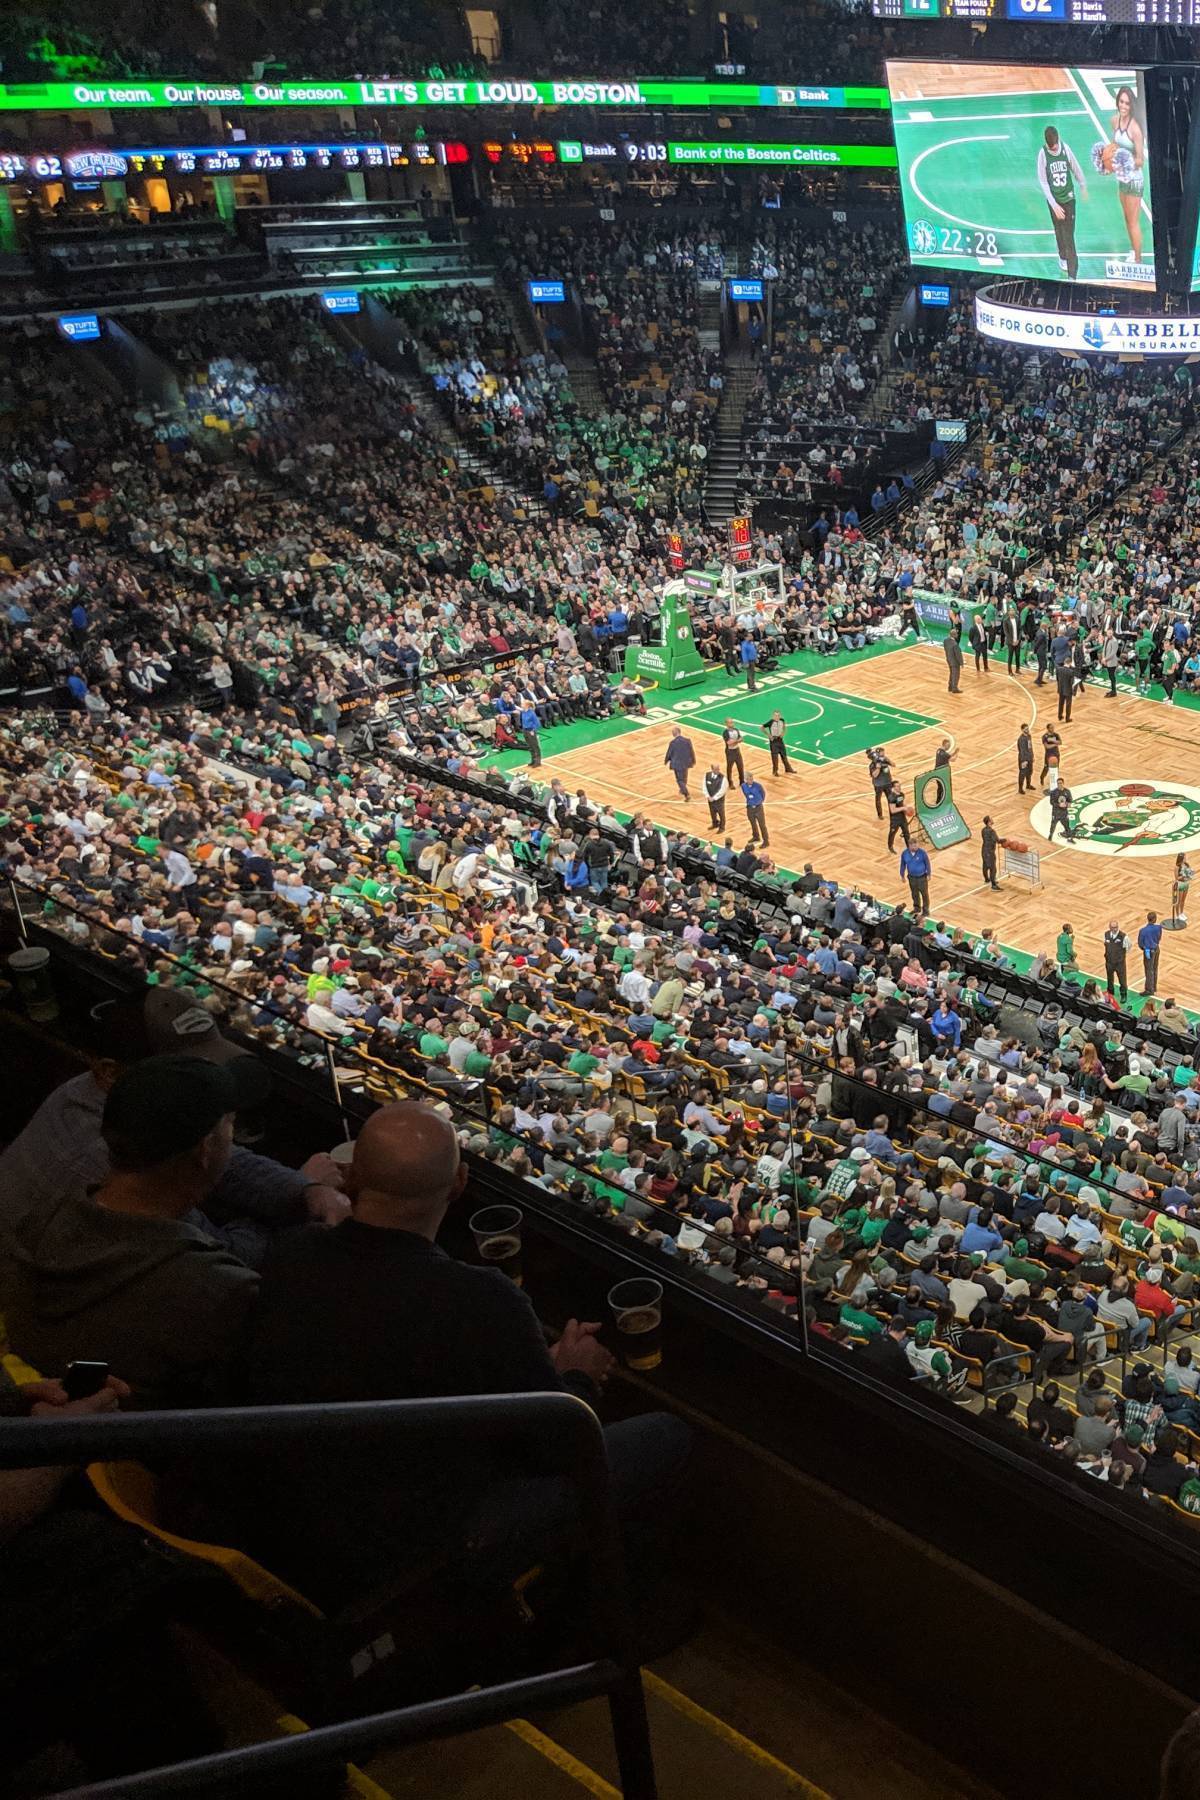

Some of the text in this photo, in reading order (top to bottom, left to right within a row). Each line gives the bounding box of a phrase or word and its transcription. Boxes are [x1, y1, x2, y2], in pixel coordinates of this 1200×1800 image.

[1083, 2, 1102, 10] Davis
[74, 83, 646, 104] Our team. Our house. Our season. LET'S GET LOUD, BOSTON.
[778, 90, 830, 102] TD Bank
[177, 152, 196, 161] FG%
[218, 150, 228, 158] FG
[344, 148, 357, 156] AST
[565, 146, 580, 158] TD
[584, 146, 616, 156] Bank
[628, 145, 667, 160] 9:03
[675, 148, 707, 160] Bank
[709, 148, 723, 160] of
[724, 148, 744, 160] the
[747, 148, 791, 160] Boston
[792, 149, 840, 162] Celtics.
[71, 153, 126, 170] NEW ORLEANS
[181, 160, 196, 170] 45
[208, 157, 240, 170] 25/55
[254, 156, 283, 168] 6/16
[293, 156, 306, 166] 10
[322, 156, 330, 166] 6
[346, 156, 359, 165] 19
[370, 155, 384, 165] 26
[36, 156, 63, 177] 62
[1050, 160, 1068, 174] CELTICS
[1052, 172, 1068, 188] 33
[940, 228, 998, 256] 22:28
[1114, 265, 1155, 276] ARBELLA
[336, 296, 357, 304] TUFTS
[74, 322, 97, 330] TUFTS
[1000, 318, 1021, 334] FOR
[1025, 322, 1070, 338] GOOD.
[642, 650, 660, 661] Boston
[673, 668, 807, 711] GARDEN
